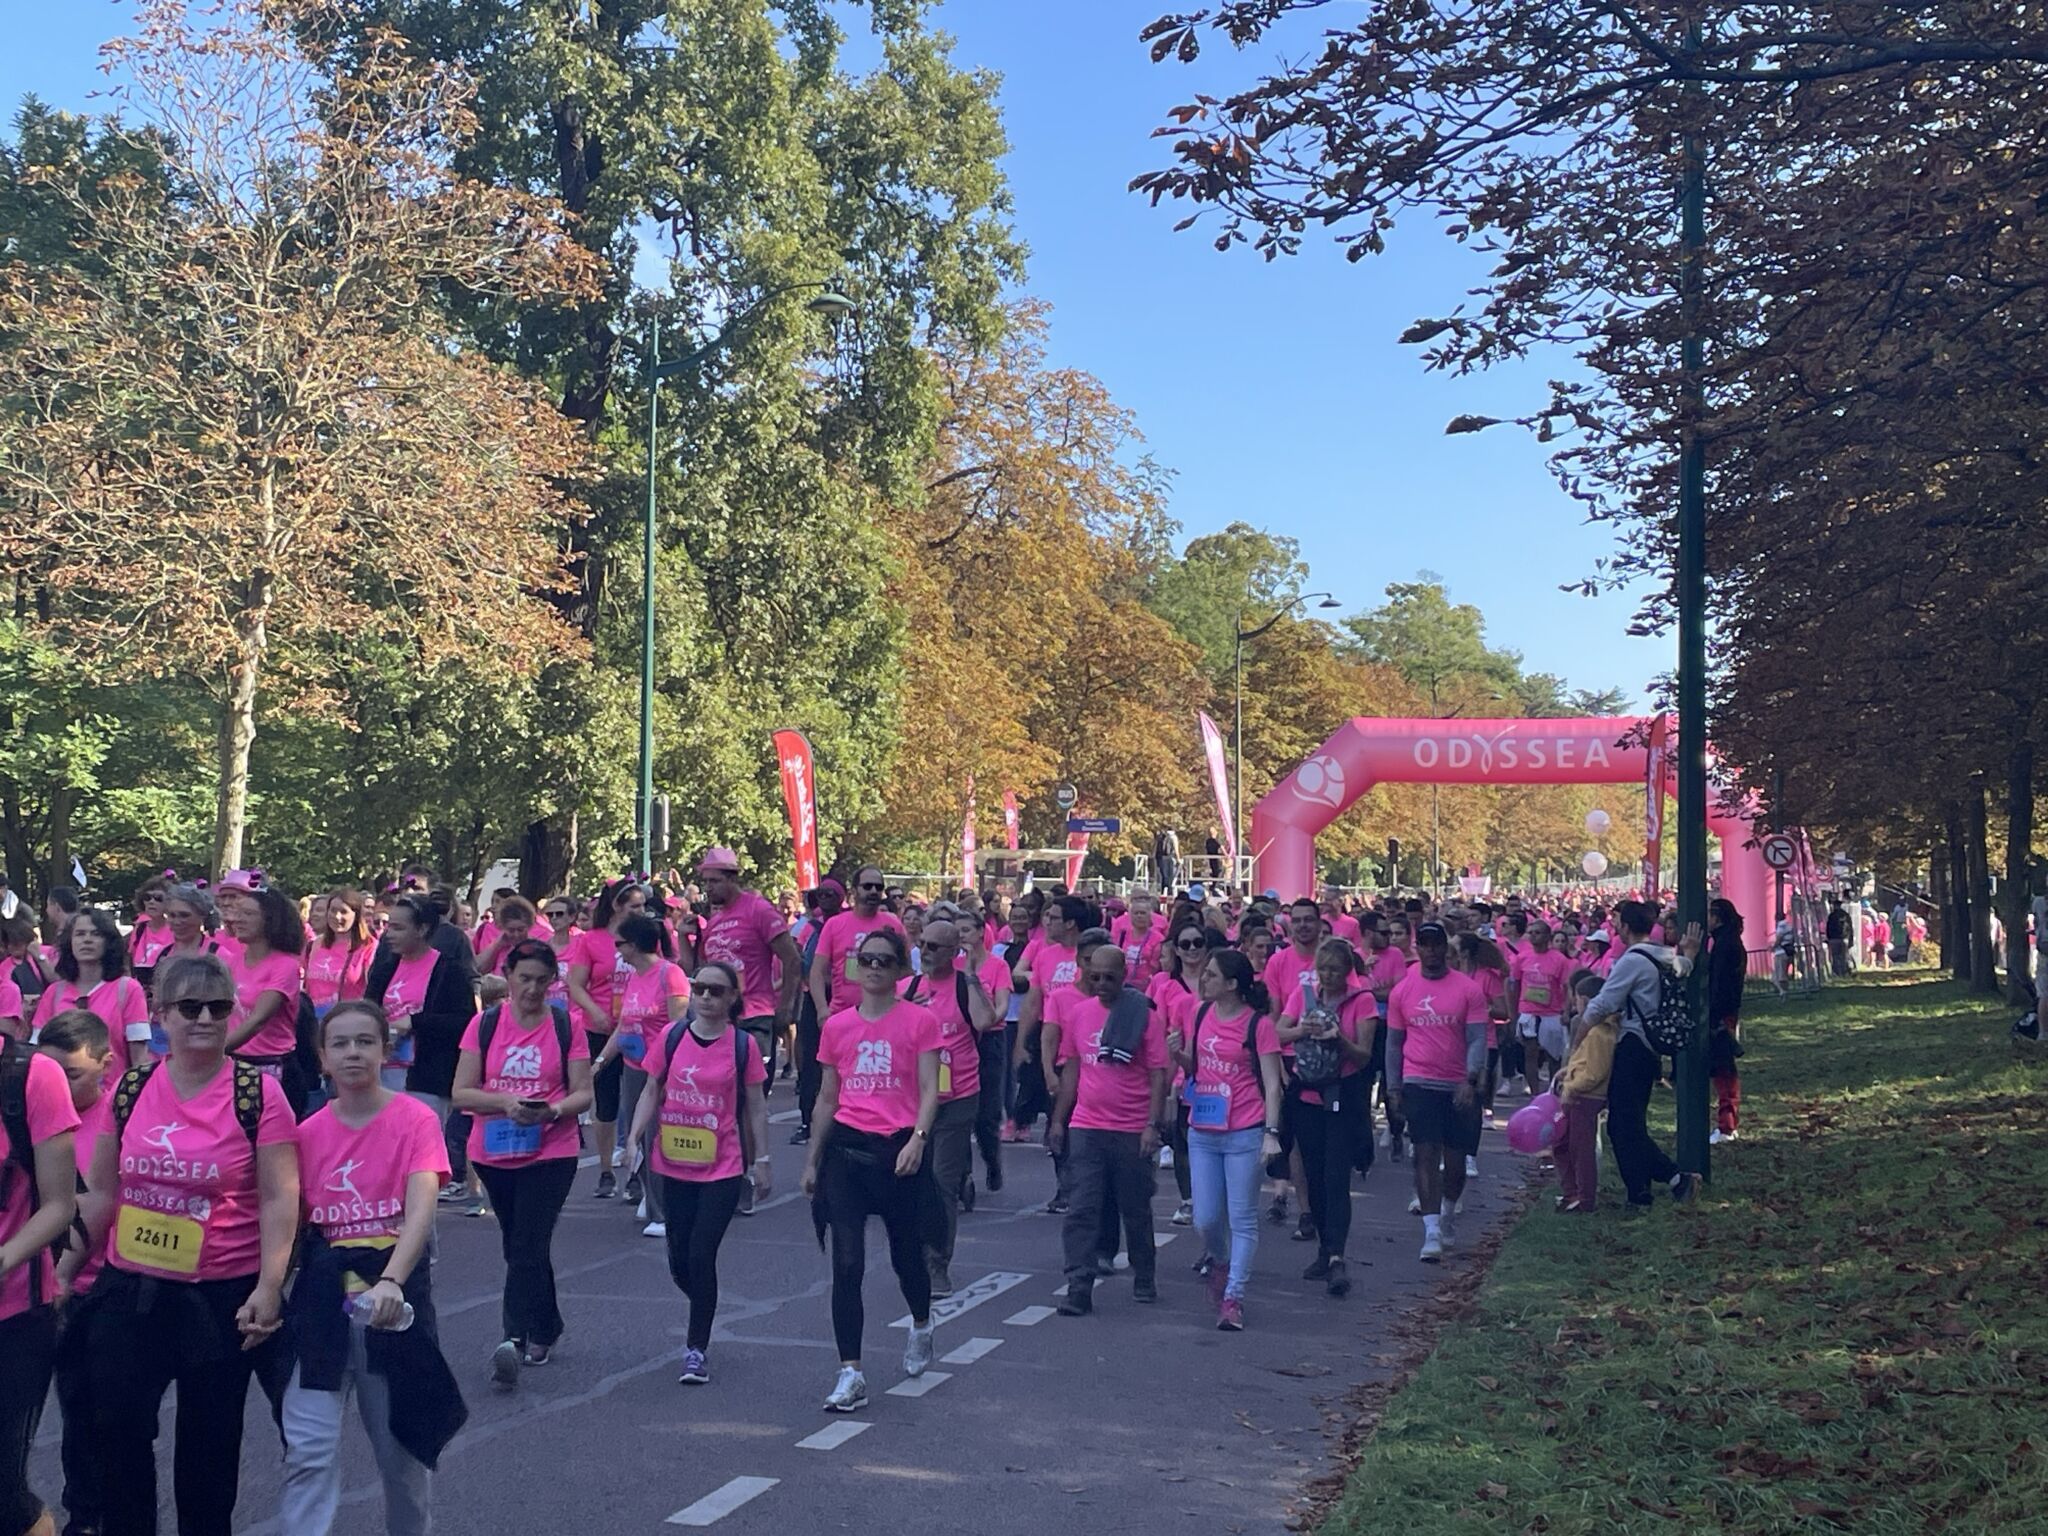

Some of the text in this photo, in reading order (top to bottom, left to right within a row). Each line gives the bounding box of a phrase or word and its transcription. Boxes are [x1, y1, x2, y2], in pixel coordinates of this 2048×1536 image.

[1413, 725, 1611, 775] ODYSSEA
[489, 1078, 551, 1093] ODYSSEA
[845, 1076, 902, 1091] ODYSSEA
[124, 1154, 220, 1179] ODYSSEA
[123, 1186, 186, 1212] ODYSSEA
[312, 1198, 403, 1225] ODYSSEA
[134, 1226, 180, 1250] 22611
